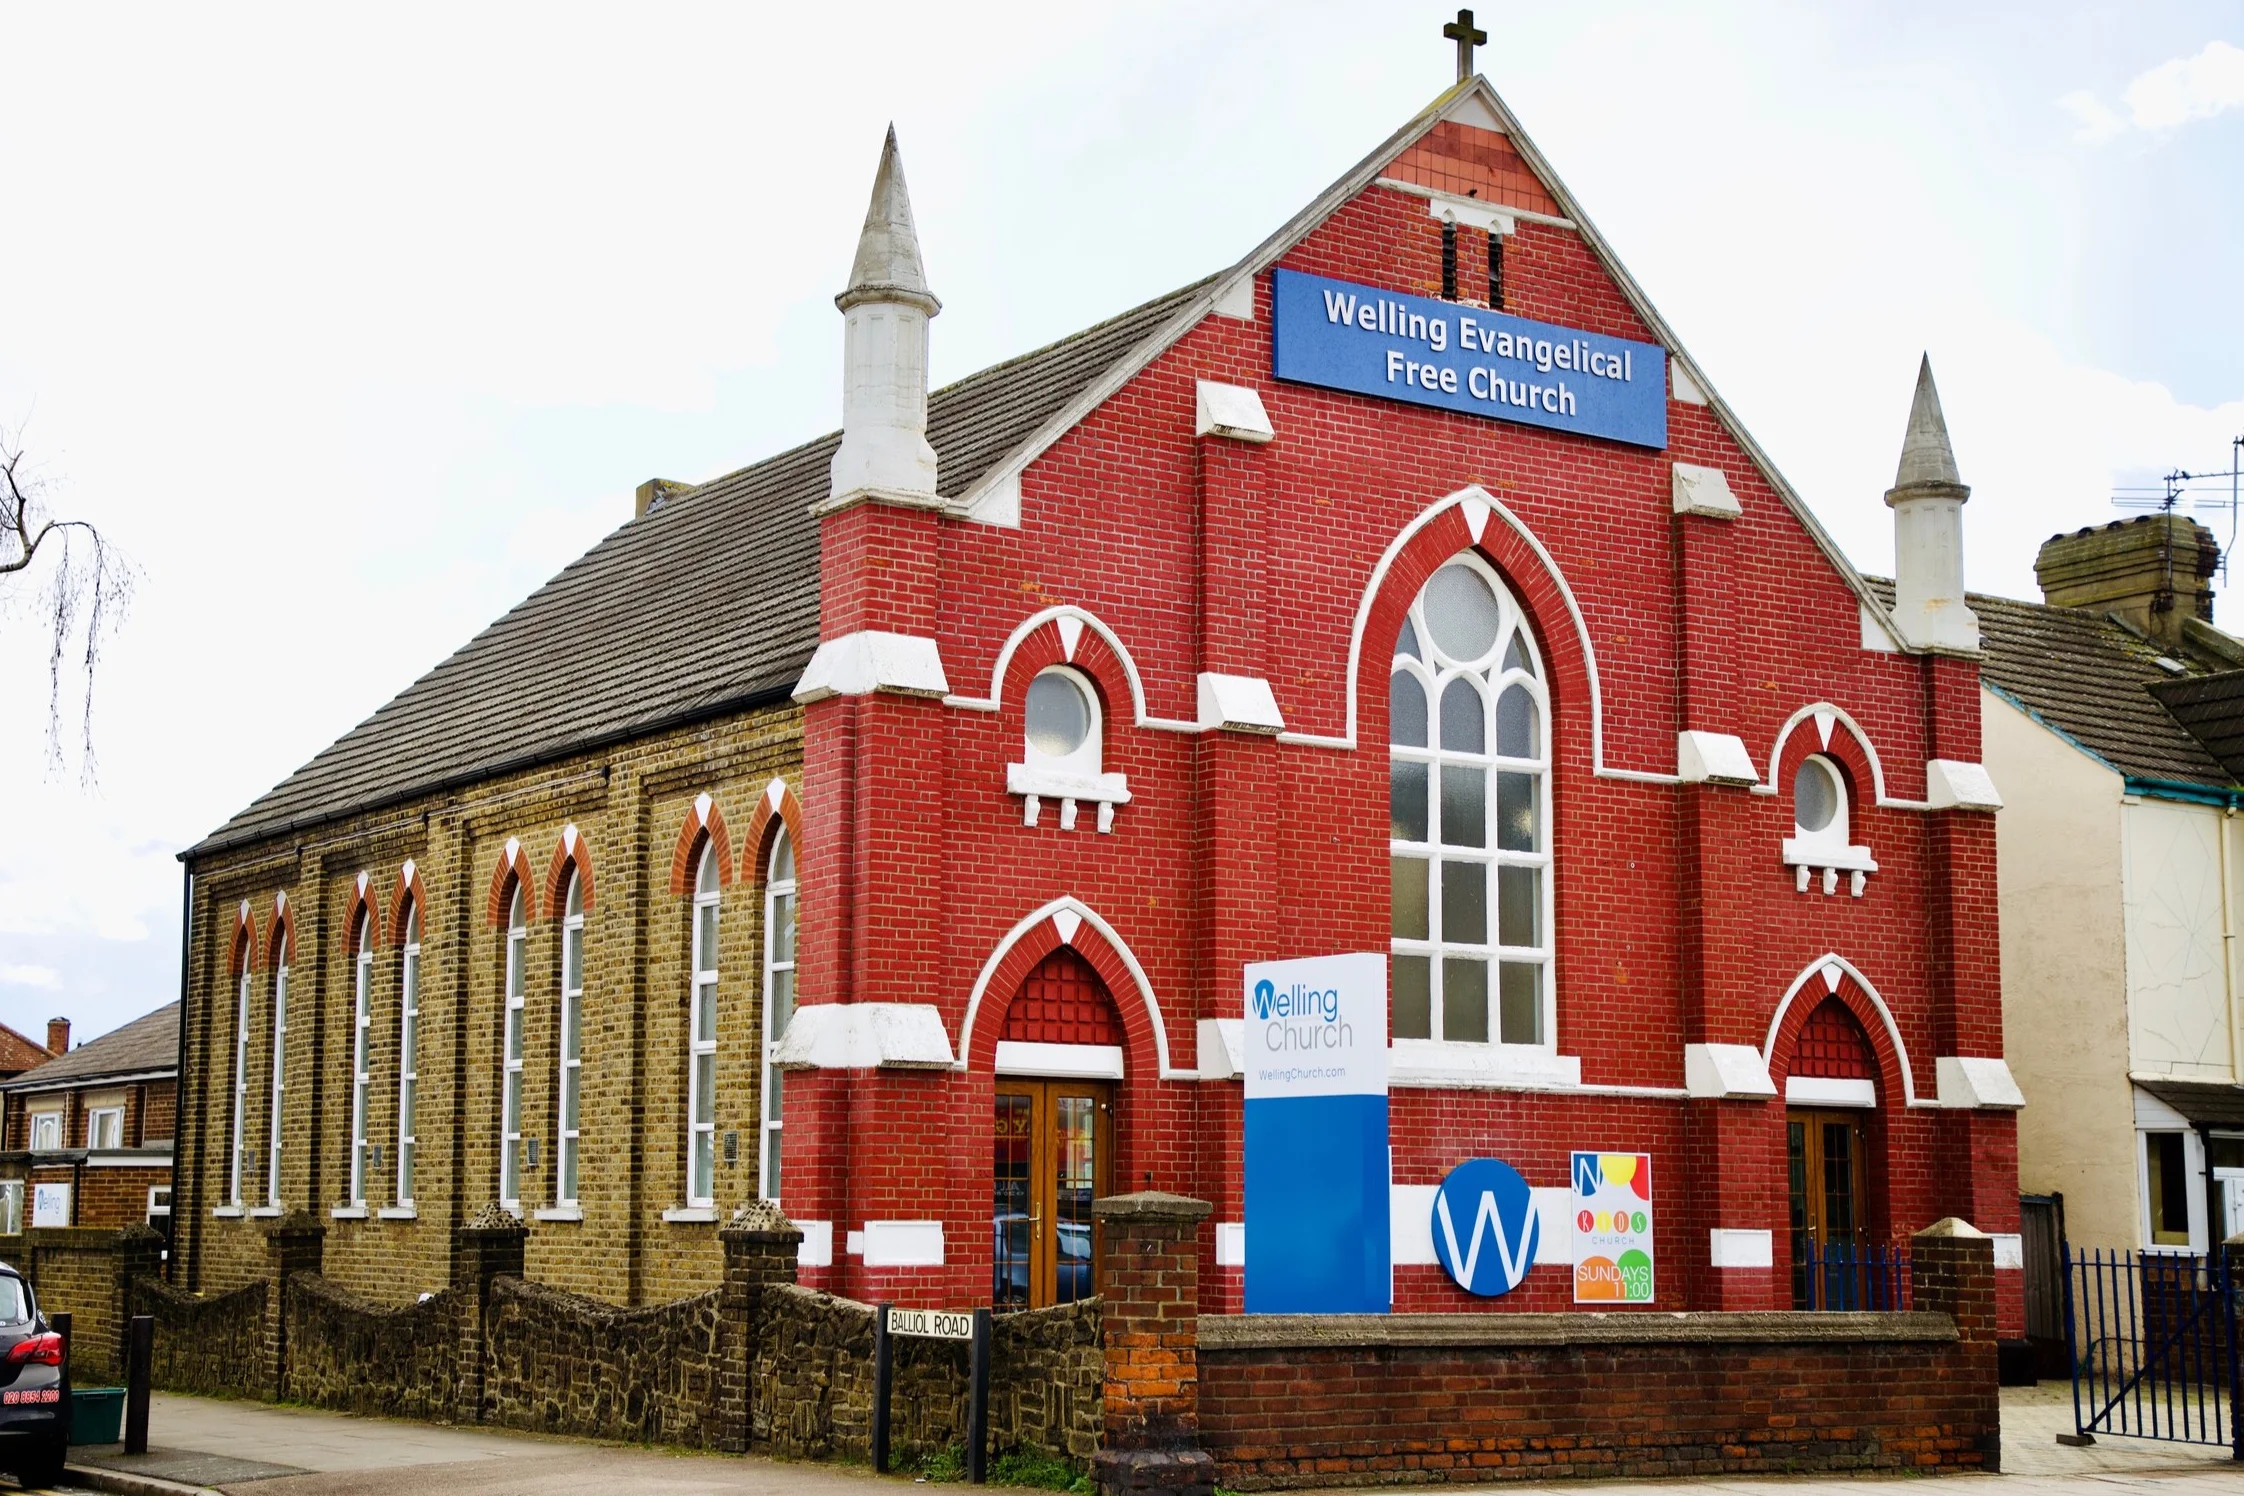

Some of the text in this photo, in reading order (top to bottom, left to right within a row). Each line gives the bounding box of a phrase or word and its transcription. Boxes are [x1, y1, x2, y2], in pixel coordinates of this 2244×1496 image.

[1323, 289, 1631, 382] Welling Evangelical
[1386, 350, 1577, 416] Free Church
[1252, 979, 1338, 1023] Welling
[1266, 1014, 1353, 1052] Church
[1258, 1066, 1346, 1083] WellingChurch.com
[1580, 1210, 1644, 1233] KIDS
[1436, 1187, 1539, 1292] W
[1591, 1236, 1636, 1245] CHURCH
[1577, 1265, 1649, 1282] SUNDAYS
[1613, 1282, 1650, 1298] 11:00
[891, 1311, 970, 1337] BALLIOL ROAD
[3, 1391, 20, 1405] 020
